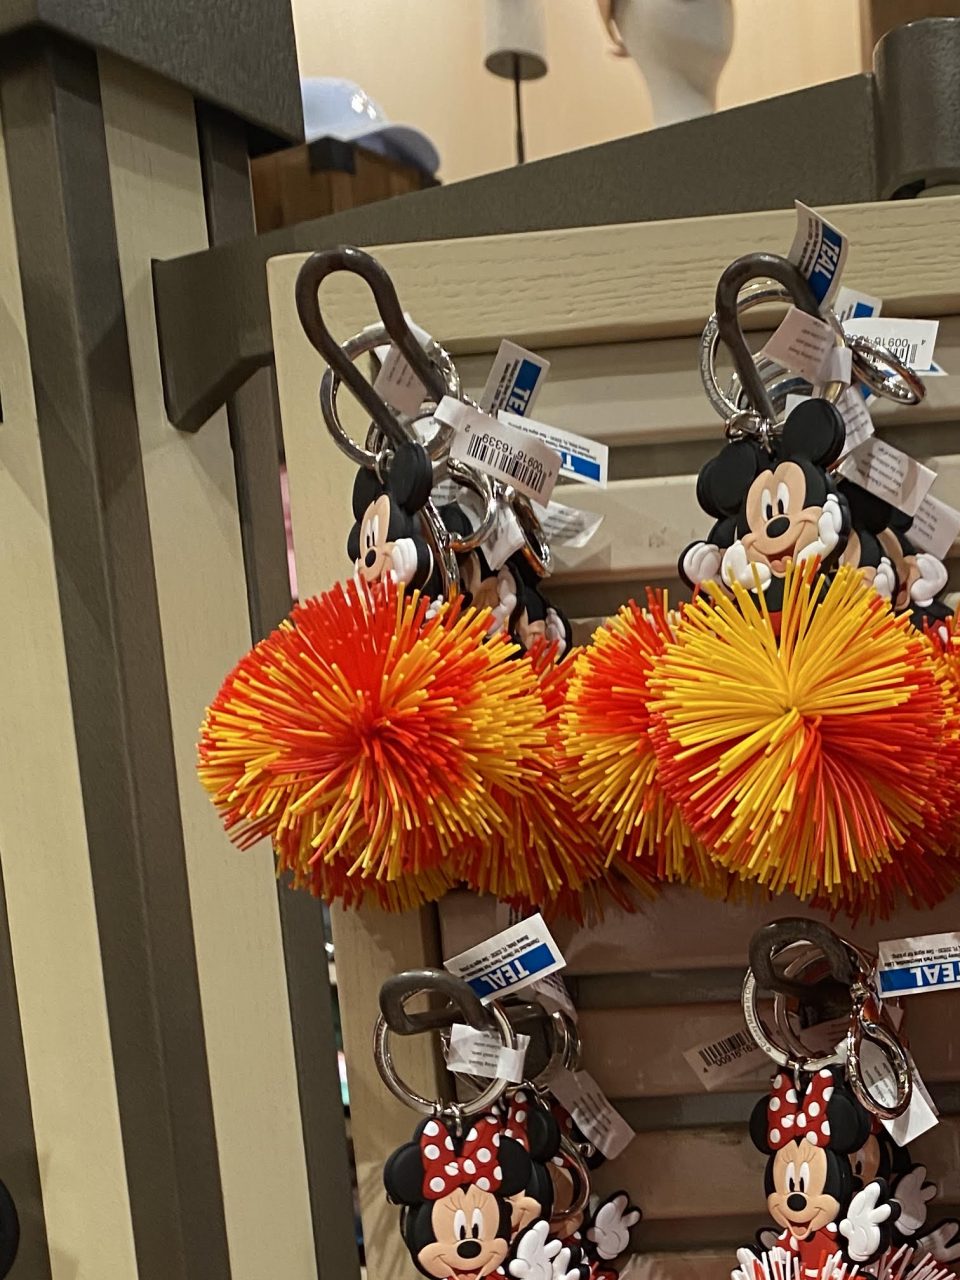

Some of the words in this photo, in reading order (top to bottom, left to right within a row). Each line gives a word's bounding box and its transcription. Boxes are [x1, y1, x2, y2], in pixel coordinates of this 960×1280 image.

[811, 237, 842, 277] TEAL
[481, 431, 514, 455] 16339
[515, 449, 544, 471] 00916
[479, 956, 529, 994] TEAL
